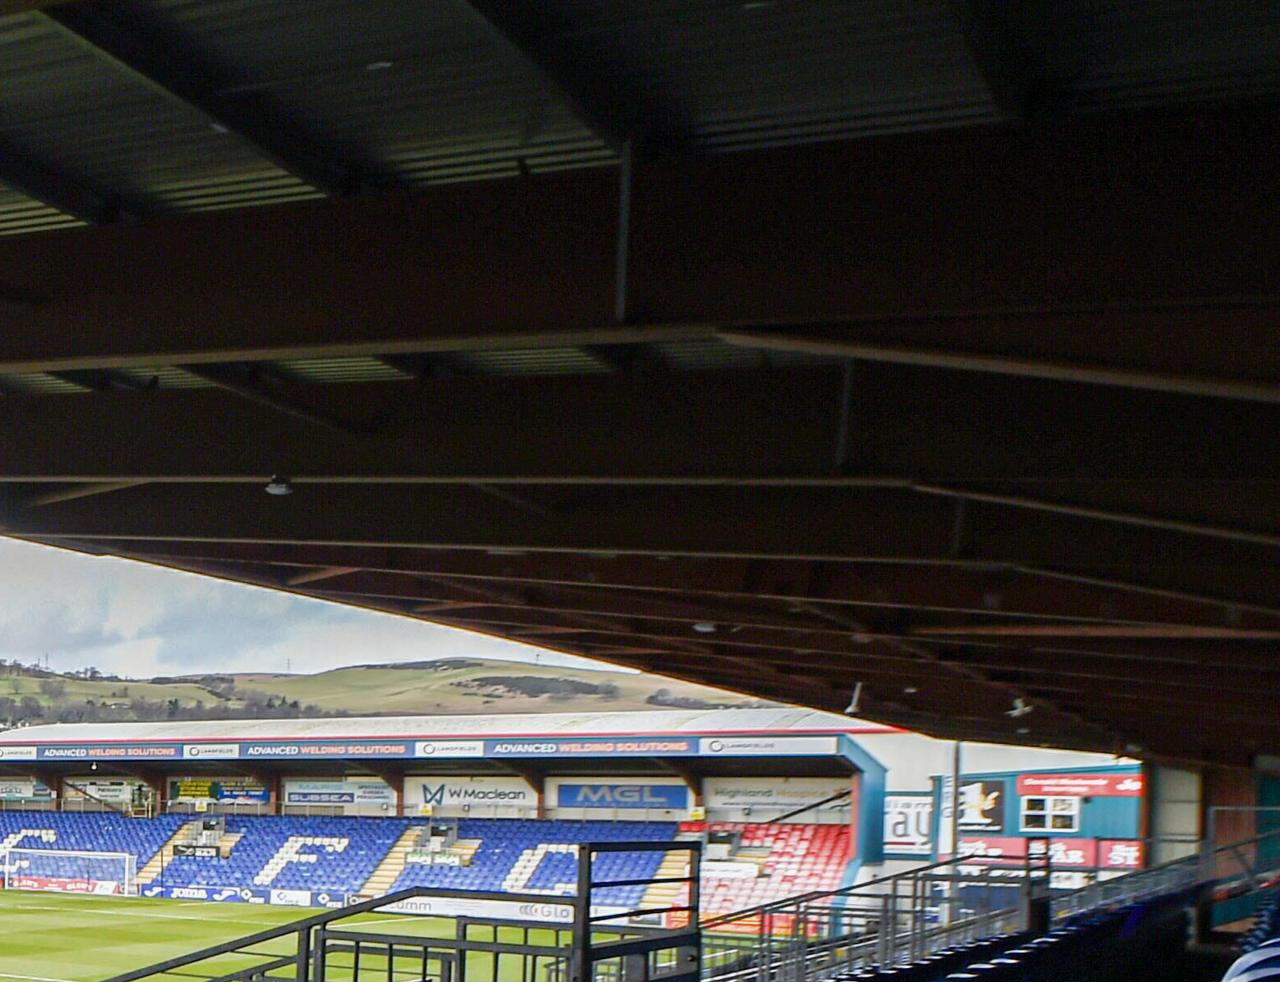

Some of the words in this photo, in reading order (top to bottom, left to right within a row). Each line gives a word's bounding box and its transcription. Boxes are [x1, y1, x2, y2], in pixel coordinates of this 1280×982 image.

[43, 748, 87, 757] ADVANCED
[88, 748, 125, 756] WELDING
[127, 748, 176, 756] SOLUTIONS
[247, 746, 299, 755] ADVANCED
[300, 746, 346, 754] WELDING
[348, 745, 405, 754] SOLUTIONS
[494, 744, 556, 753] ADVANCED
[559, 743, 615, 752] WELDING
[617, 742, 688, 751] SOLUTIONS
[576, 786, 668, 802] MGL
[714, 788, 773, 798] Highland
